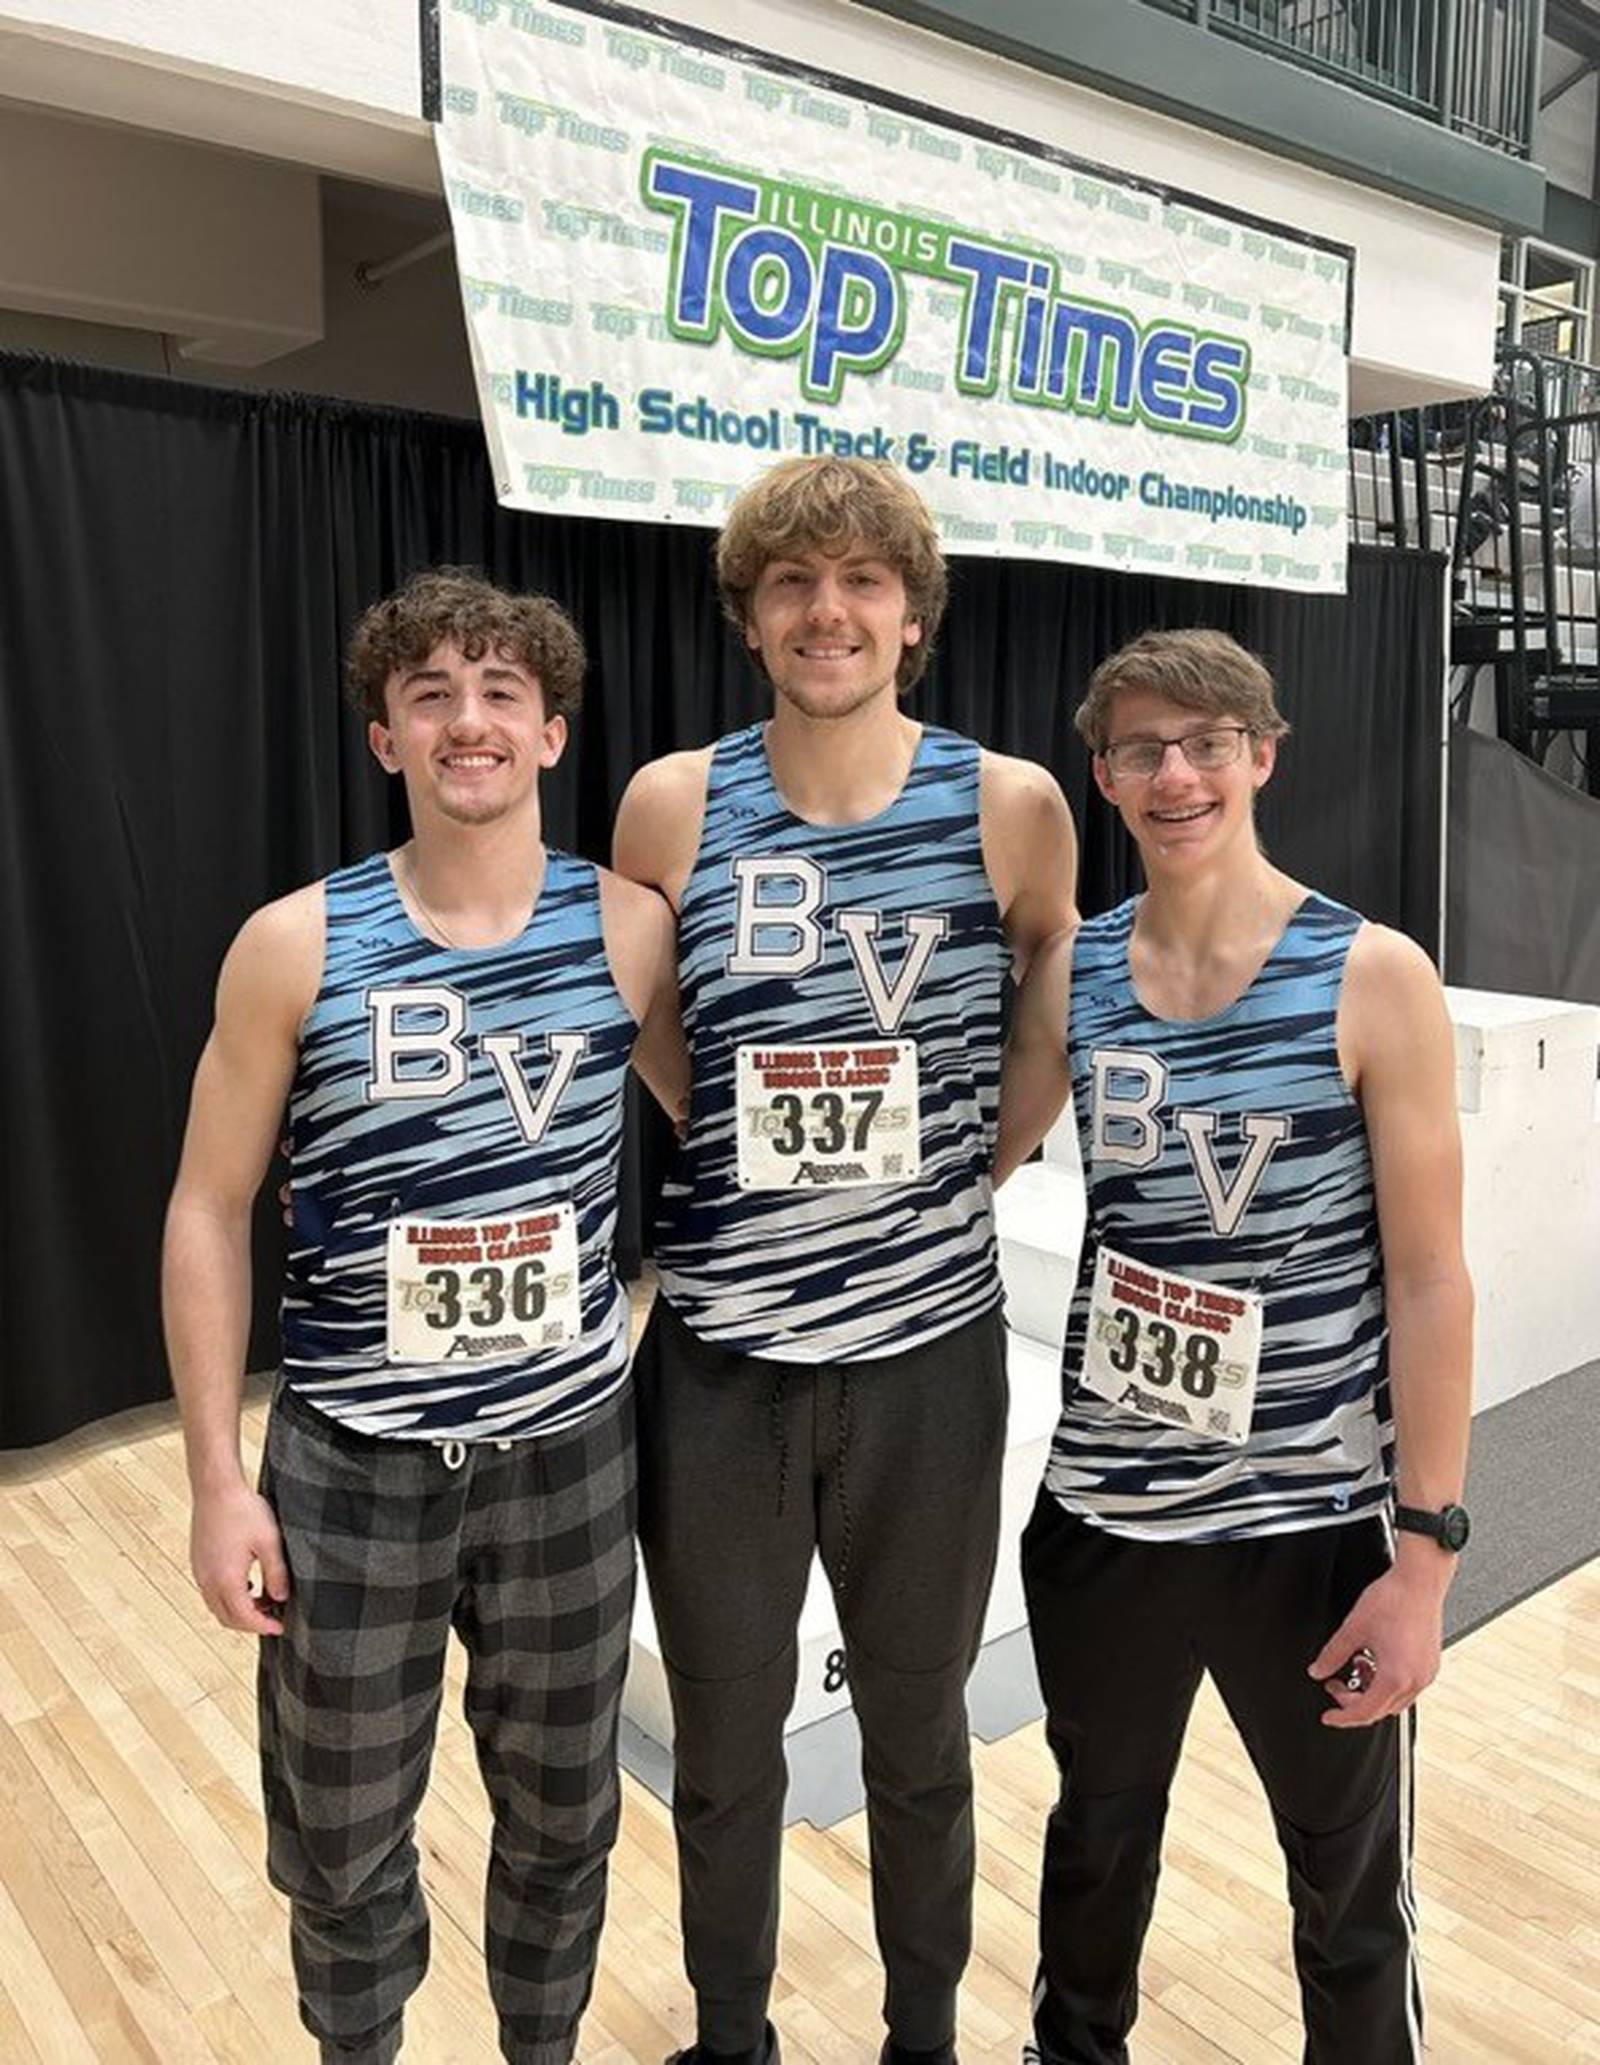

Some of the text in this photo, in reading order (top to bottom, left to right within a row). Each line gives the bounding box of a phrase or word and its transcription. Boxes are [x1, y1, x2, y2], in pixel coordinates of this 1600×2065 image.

[770, 191, 939, 261] ILLINOIS
[649, 158, 897, 391] Top
[516, 369, 619, 435] High
[638, 389, 780, 449] School
[795, 412, 894, 458] Track
[906, 433, 936, 473] &
[950, 439, 1029, 485] Field
[1044, 452, 1129, 502] Indoor
[1139, 471, 1307, 535] Championship
[753, 1046, 900, 1069] ILLINOIS TOP TIMES
[763, 1068, 891, 1089] INDOOR CLASSIC
[1537, 1038, 1545, 1070] 1
[770, 1091, 884, 1155] 337
[407, 1213, 560, 1244] ILLINOIS TOP TIMES
[418, 1236, 551, 1264] INDOOR CLASSIC
[425, 1259, 547, 1329] 336
[1108, 1258, 1246, 1317] ILLINOIS TOP TIMES
[1112, 1281, 1232, 1334] INDOOR CLASSIC
[1109, 1307, 1220, 1399] 338
[824, 1649, 846, 1693] 8
